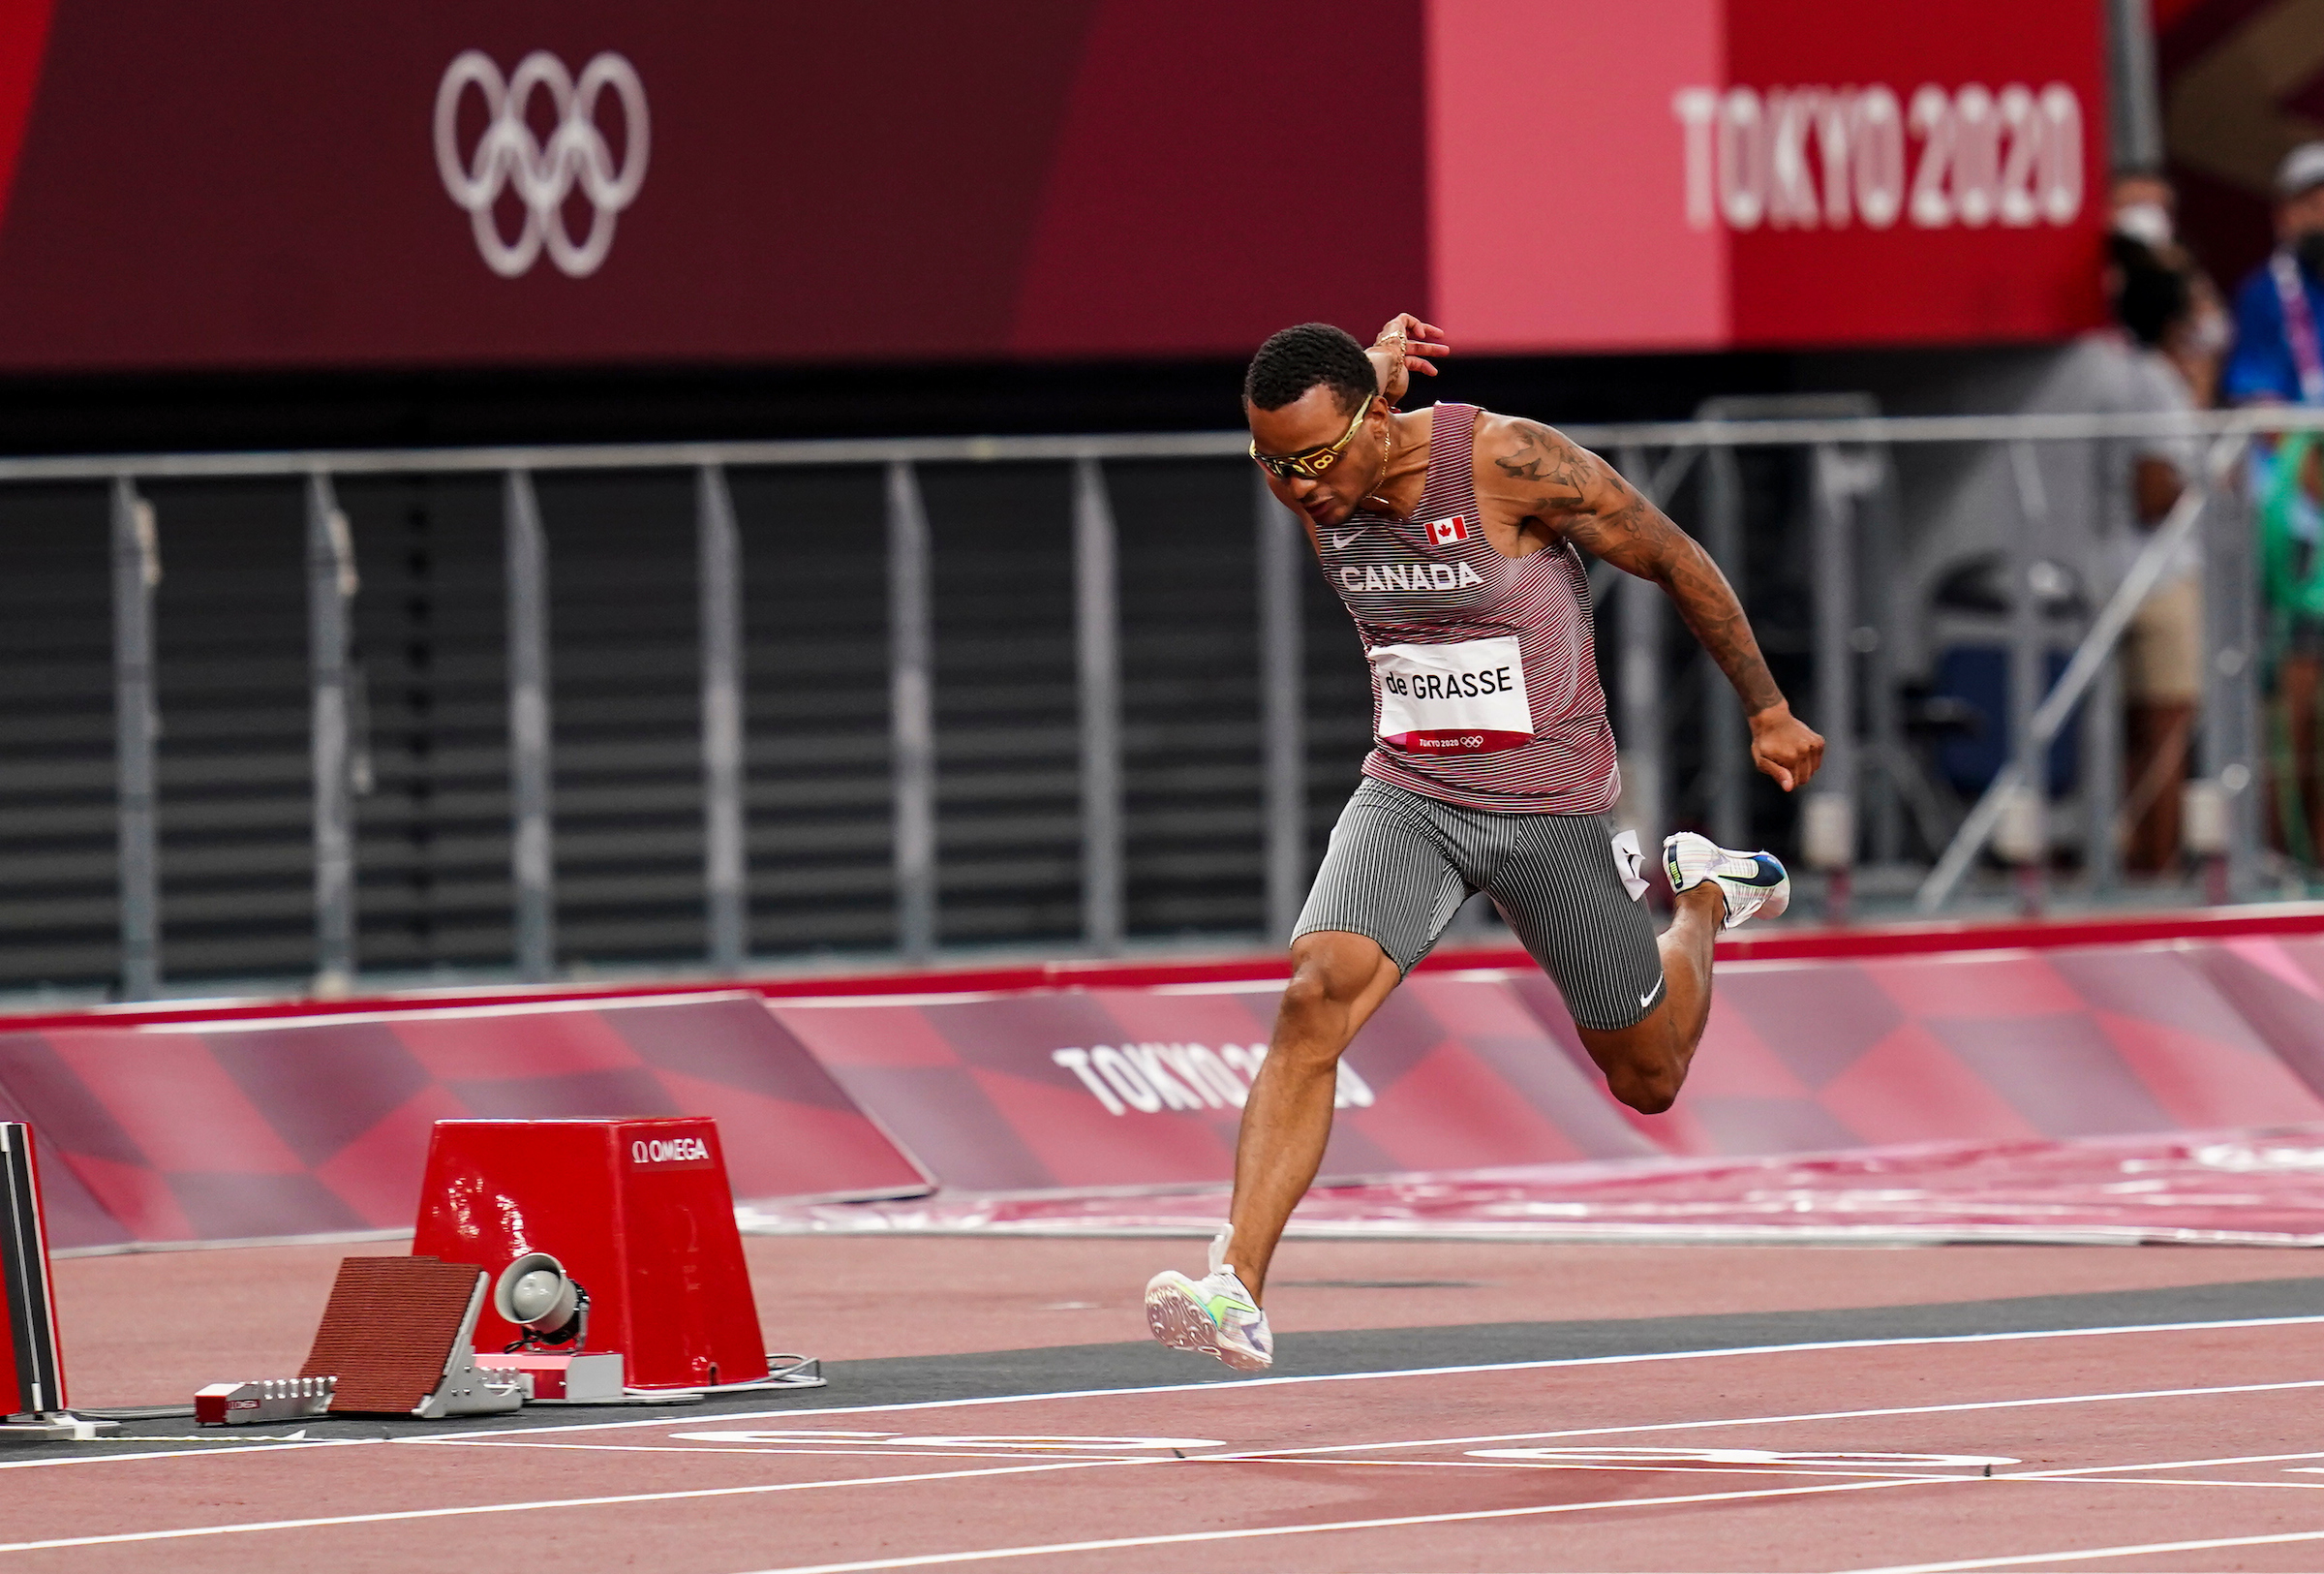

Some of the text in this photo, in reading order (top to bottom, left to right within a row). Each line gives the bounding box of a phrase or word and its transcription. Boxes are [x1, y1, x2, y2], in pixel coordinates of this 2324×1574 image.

[1672, 81, 2084, 231] TOKYO 2020
[1340, 562, 1484, 592] CANADA
[1386, 666, 1513, 699] de GRASSE
[1419, 738, 1459, 748] TOKYO 2020
[1051, 1041, 1252, 1116] TOKYO
[649, 1137, 709, 1162] OMEGA
